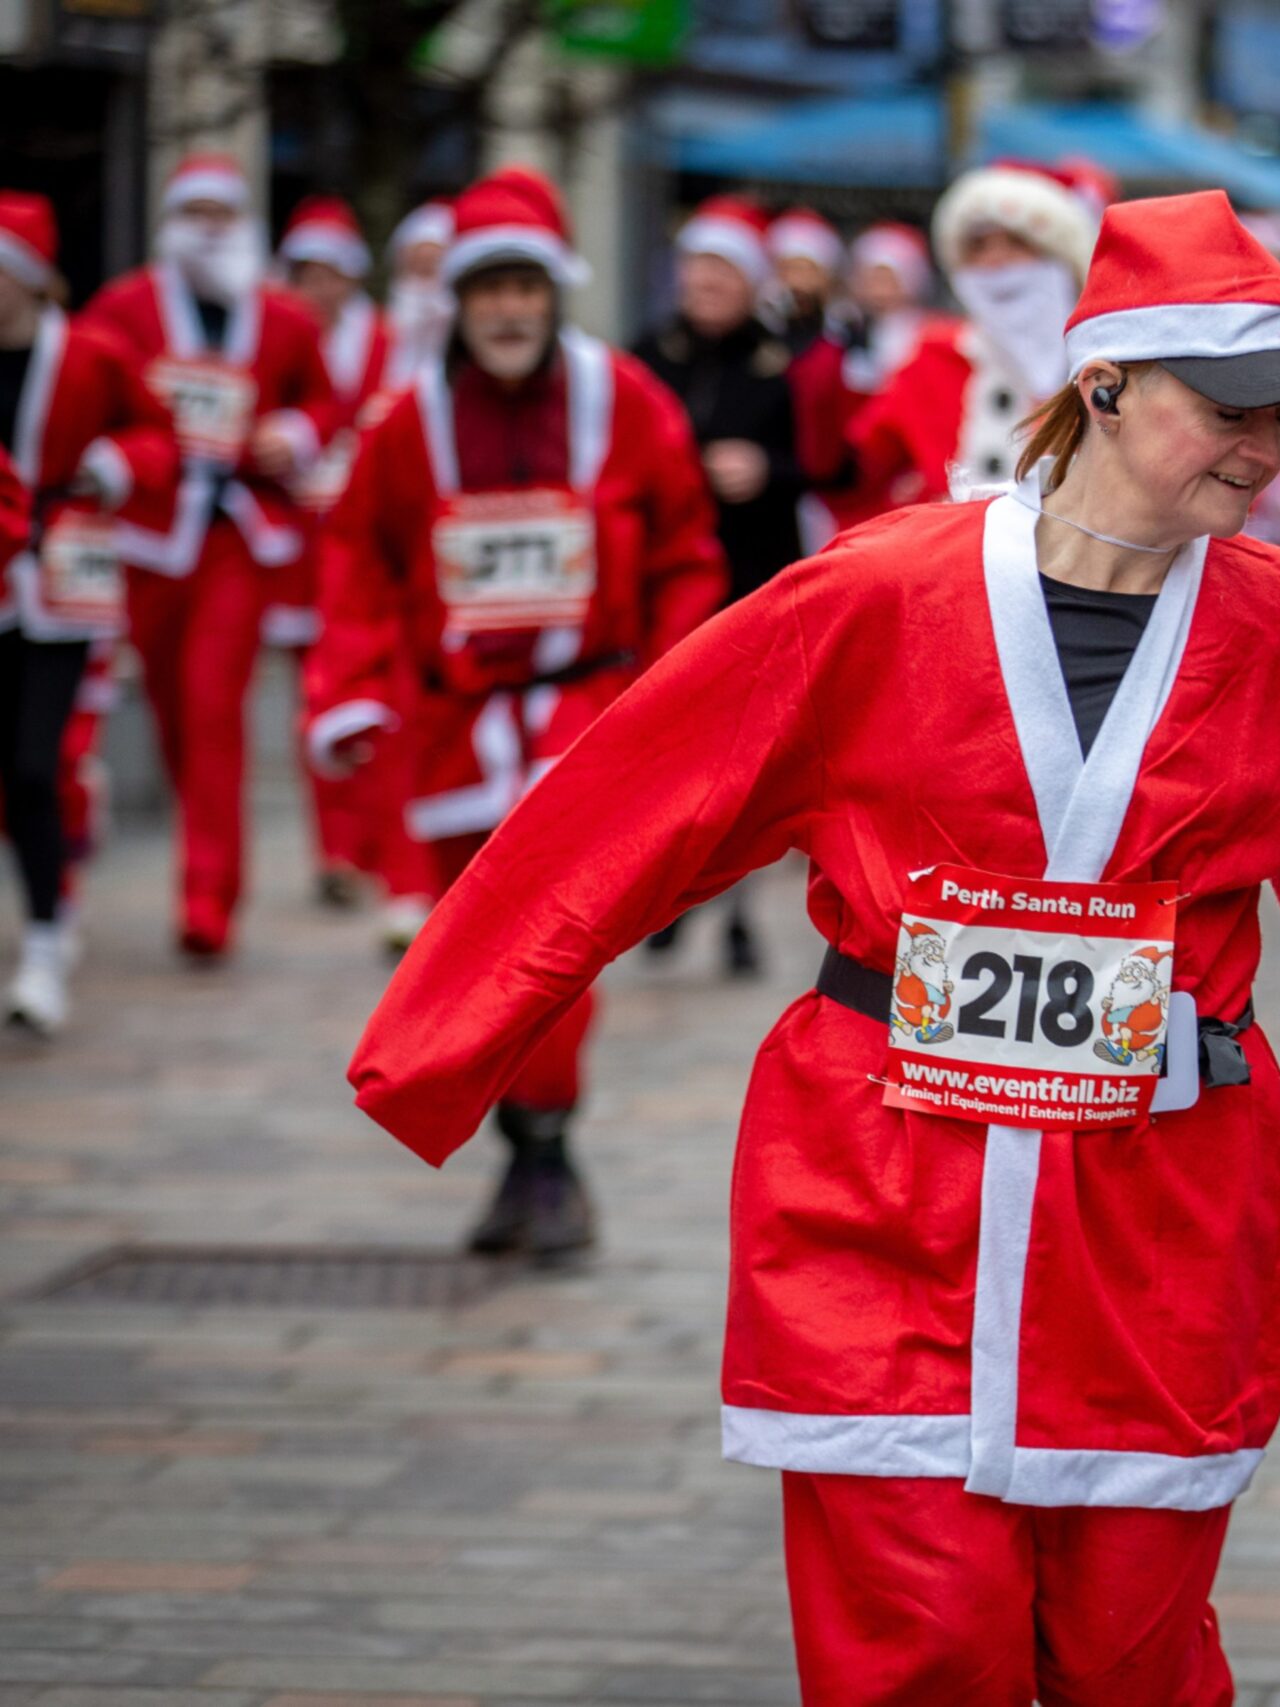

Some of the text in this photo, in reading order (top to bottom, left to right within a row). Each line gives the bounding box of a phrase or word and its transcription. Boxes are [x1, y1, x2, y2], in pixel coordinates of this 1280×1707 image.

[941, 880, 1136, 918] Perth Santa Run
[957, 951, 1094, 1048] 218
[901, 1061, 1140, 1104] www.eventfull.biz
[900, 1084, 943, 1106] Timing
[951, 1093, 1020, 1117] Equipment
[1028, 1104, 1075, 1120] Entries
[1084, 1107, 1137, 1122] Supplies
